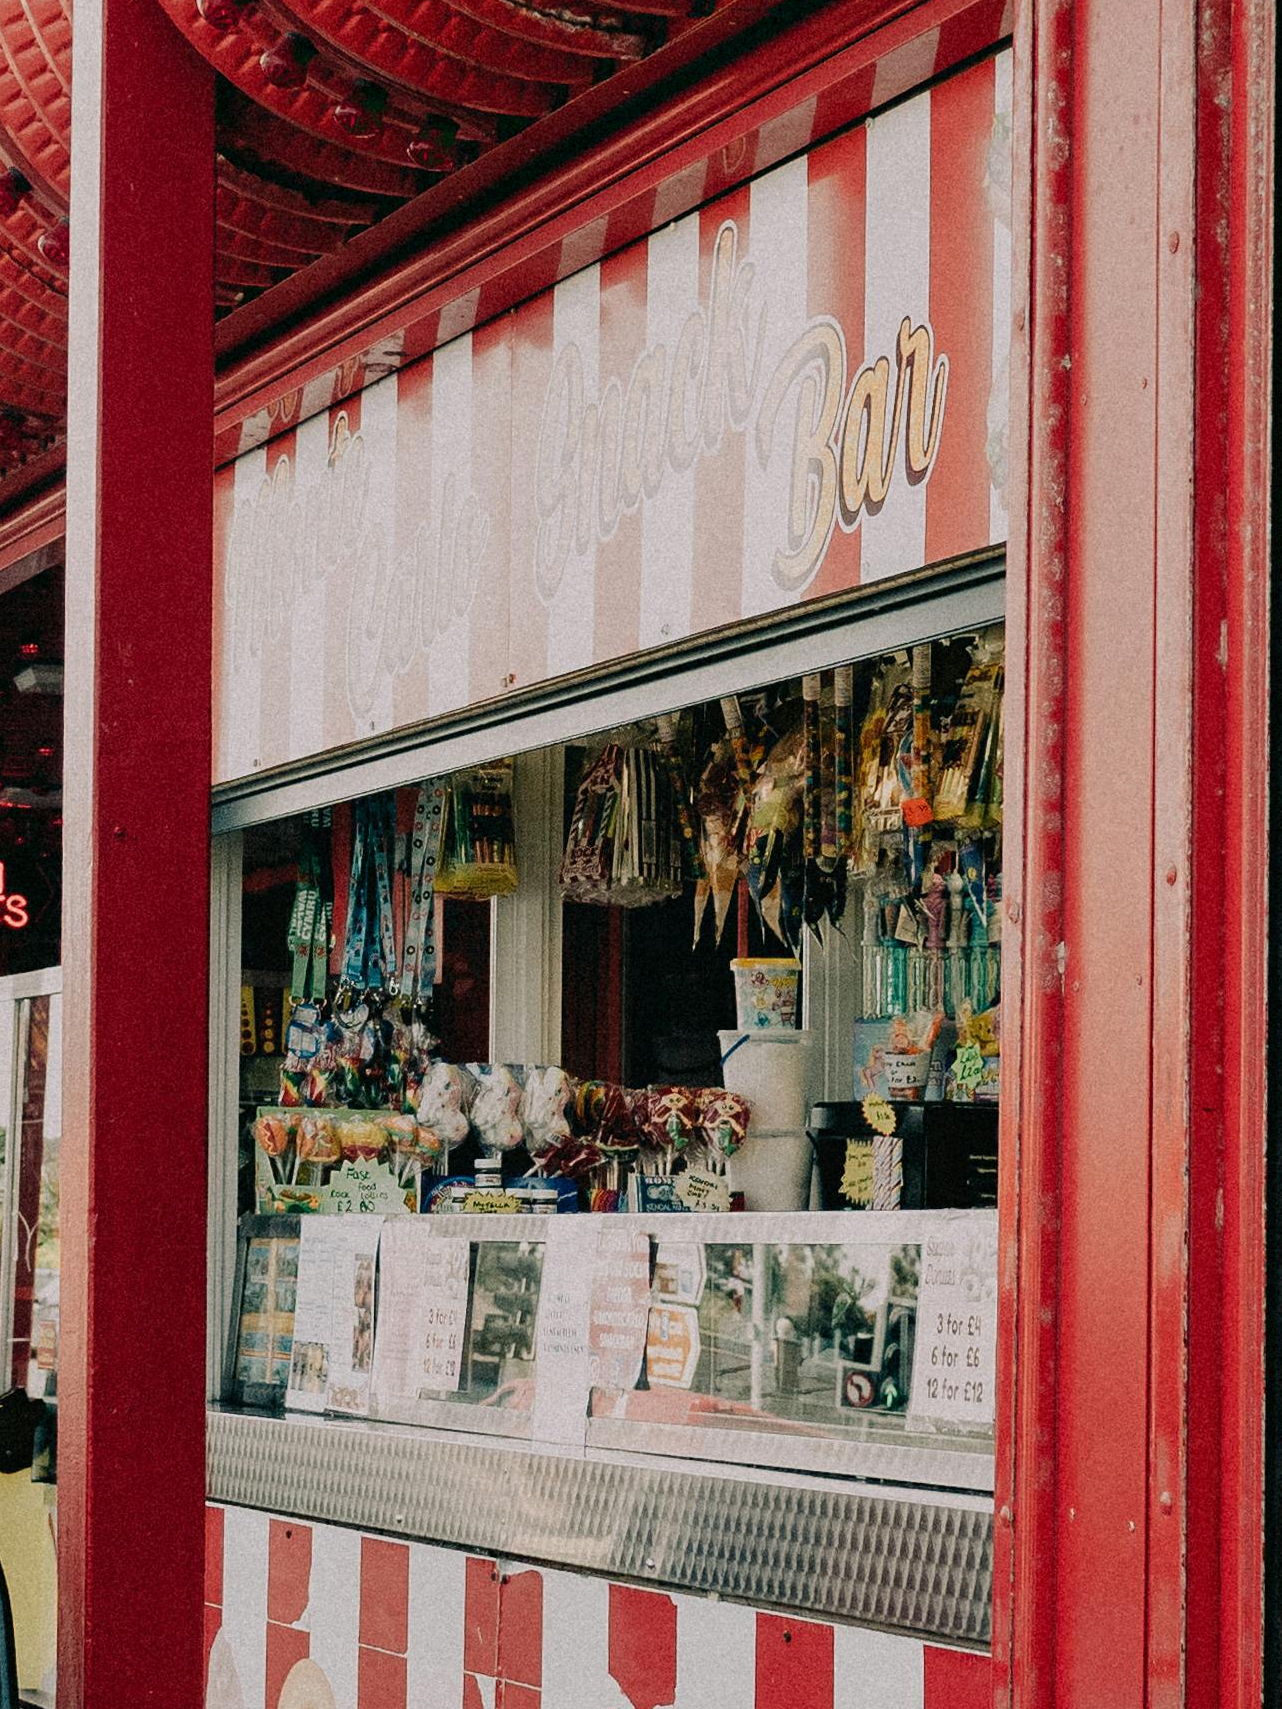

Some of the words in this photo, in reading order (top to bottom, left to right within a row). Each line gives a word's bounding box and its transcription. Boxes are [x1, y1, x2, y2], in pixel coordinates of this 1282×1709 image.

[756, 315, 950, 591] Bar
[937, 1313, 943, 1334] 3
[946, 1312, 964, 1331] for
[967, 1314, 983, 1337] £4
[931, 1346, 938, 1367] 6
[941, 1345, 959, 1367] for
[966, 1347, 980, 1368] £6
[927, 1378, 938, 1399] 12
[942, 1378, 959, 1402] for
[963, 1381, 984, 1403] £12
